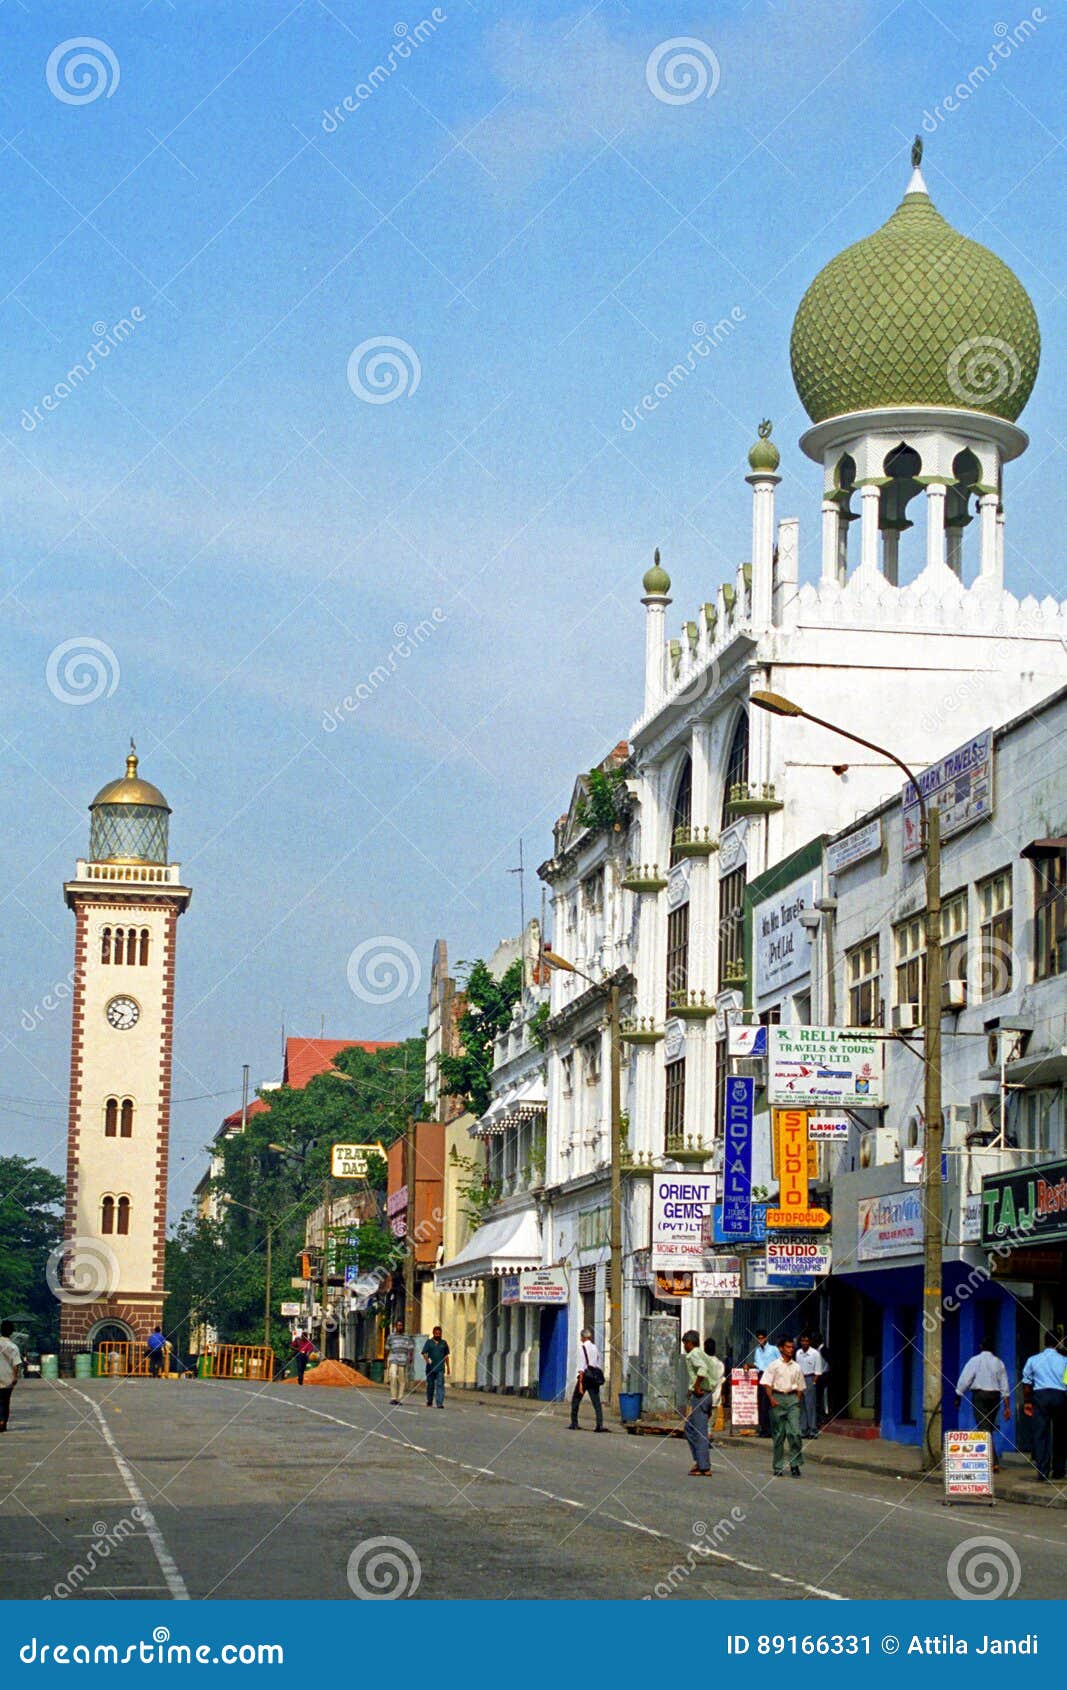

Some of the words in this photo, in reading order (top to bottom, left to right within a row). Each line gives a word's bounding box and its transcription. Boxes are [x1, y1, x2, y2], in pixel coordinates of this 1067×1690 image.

[800, 1030, 877, 1043] RELIANCE
[779, 1044, 826, 1052] TRAVELS
[842, 1046, 875, 1054] TOURS
[730, 1105, 748, 1193] ROYAL
[785, 1112, 801, 1205] STUDIO
[659, 1184, 710, 1200] ORIENT
[664, 1202, 703, 1219] GEMS
[983, 1181, 1035, 1234] TAJ
[657, 1245, 678, 1254] MONEY
[681, 1245, 704, 1255] CHANG
[768, 1245, 818, 1256] STUDIO
[775, 1263, 822, 1272] PHOTOGRAPHS
[949, 1432, 968, 1441] FOTO
